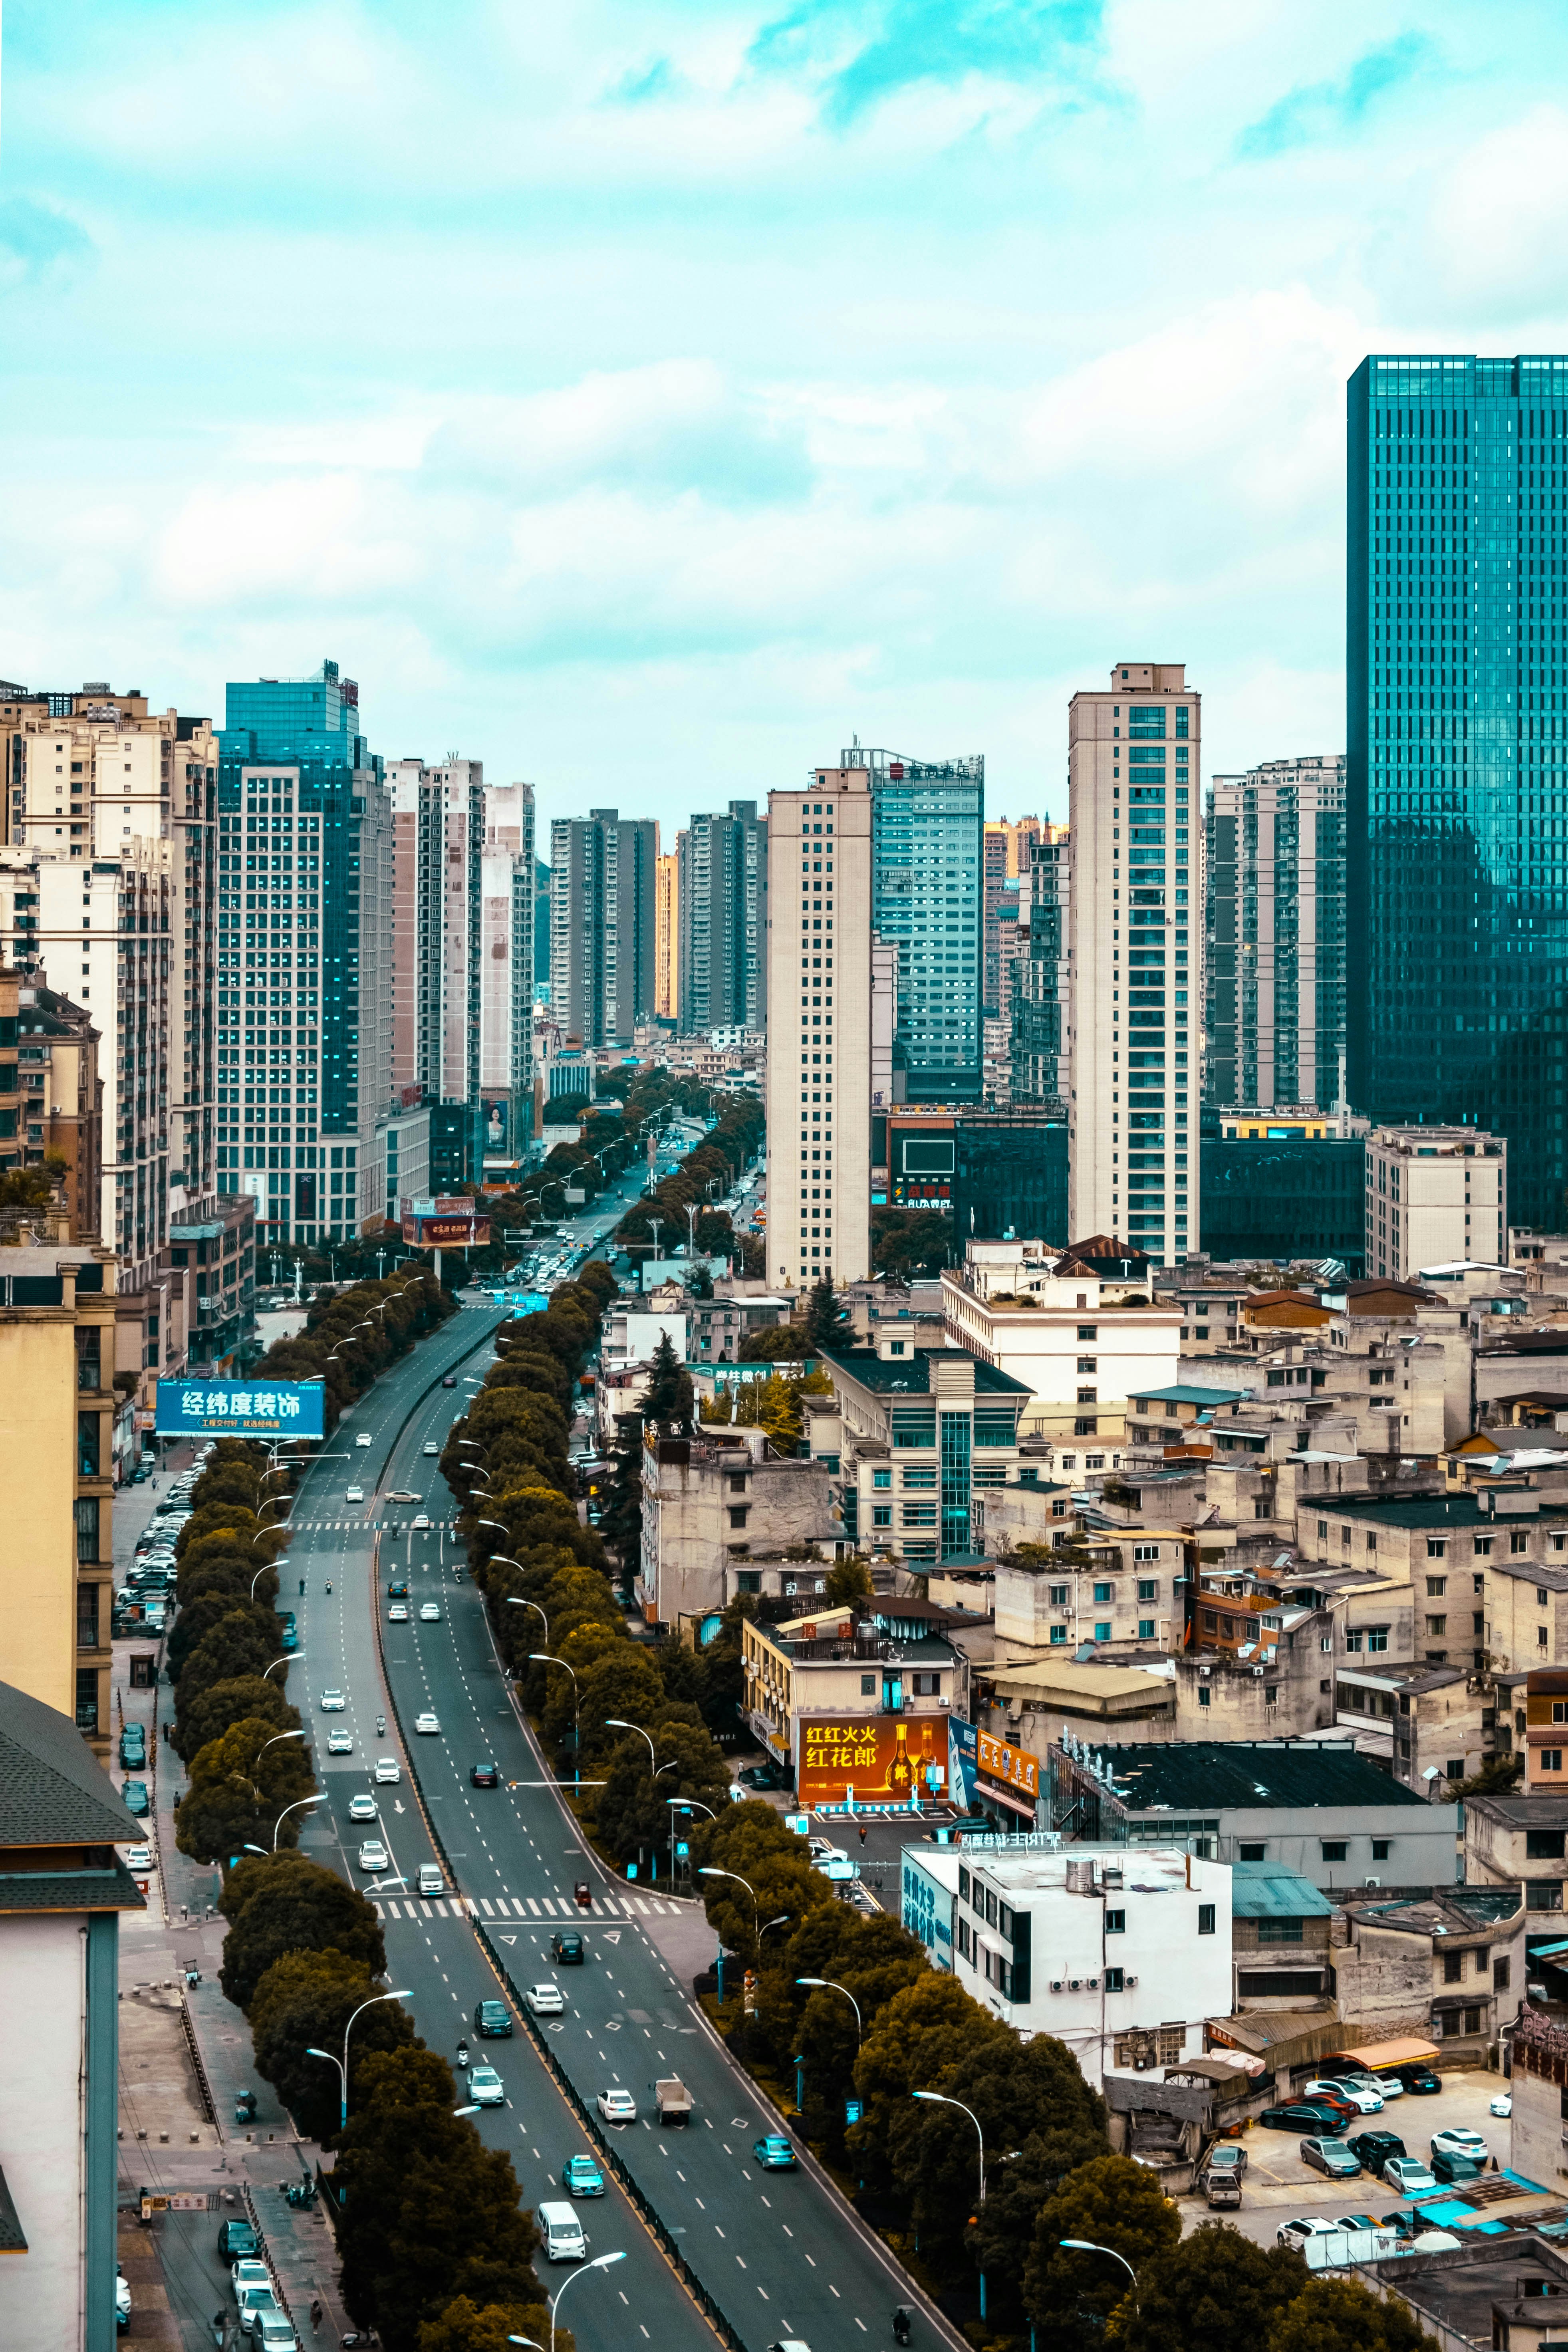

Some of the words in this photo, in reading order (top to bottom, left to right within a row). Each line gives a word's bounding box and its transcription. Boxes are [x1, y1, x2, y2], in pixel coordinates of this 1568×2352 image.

[908, 1199, 950, 1208] HUAWEI
[182, 1391, 300, 1417] 经纬度装饰
[806, 1725, 876, 1743] 红红火火
[806, 1746, 877, 1768] 红花郎
